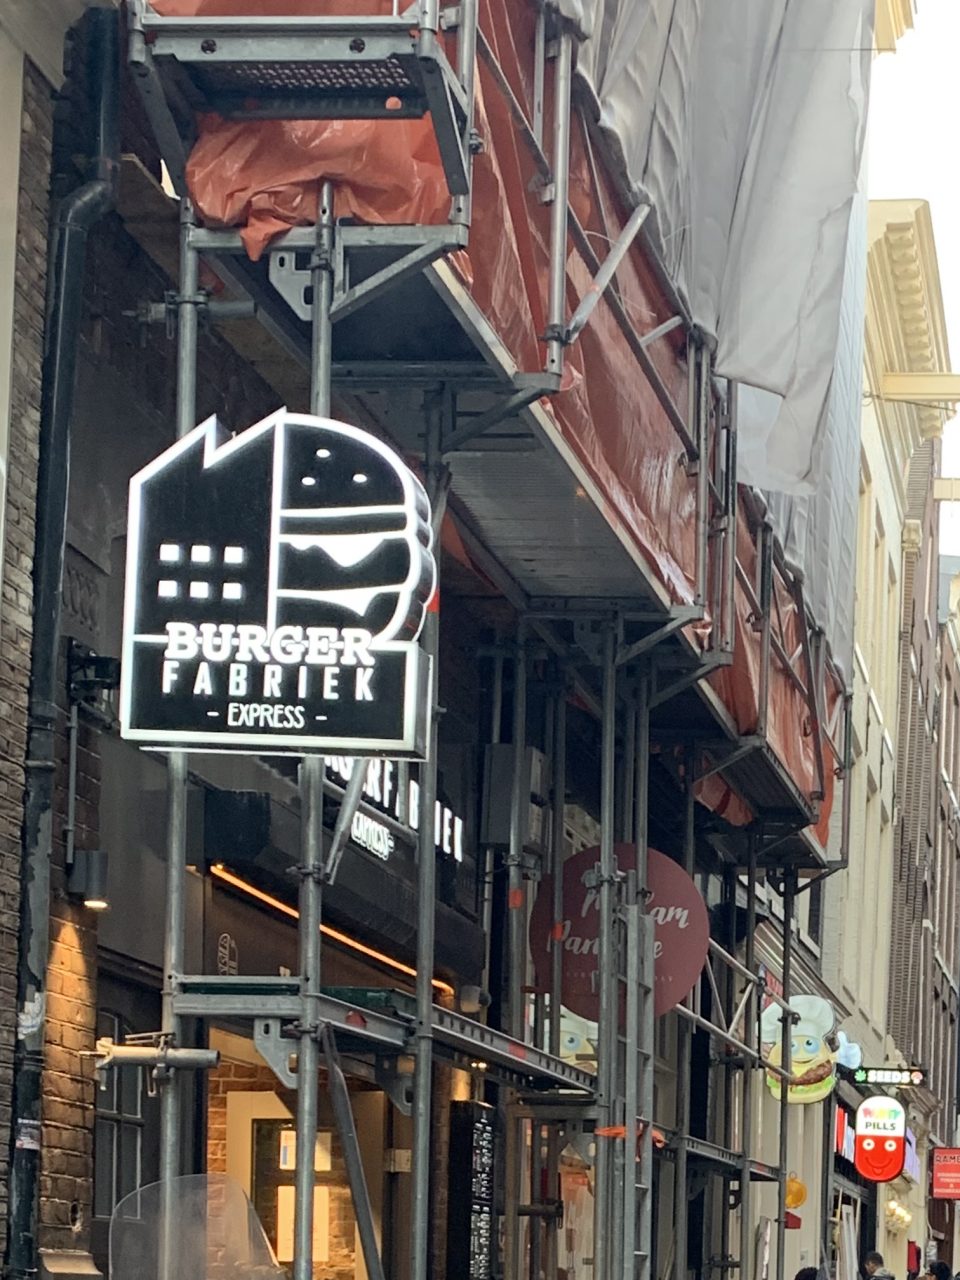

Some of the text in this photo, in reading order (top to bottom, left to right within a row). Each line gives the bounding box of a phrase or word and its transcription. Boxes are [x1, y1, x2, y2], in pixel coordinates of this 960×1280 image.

[164, 622, 376, 666] BURGER
[162, 660, 374, 701] FABRIEK
[867, 1070, 911, 1083] SEEDS
[865, 1121, 897, 1131] PILLS
